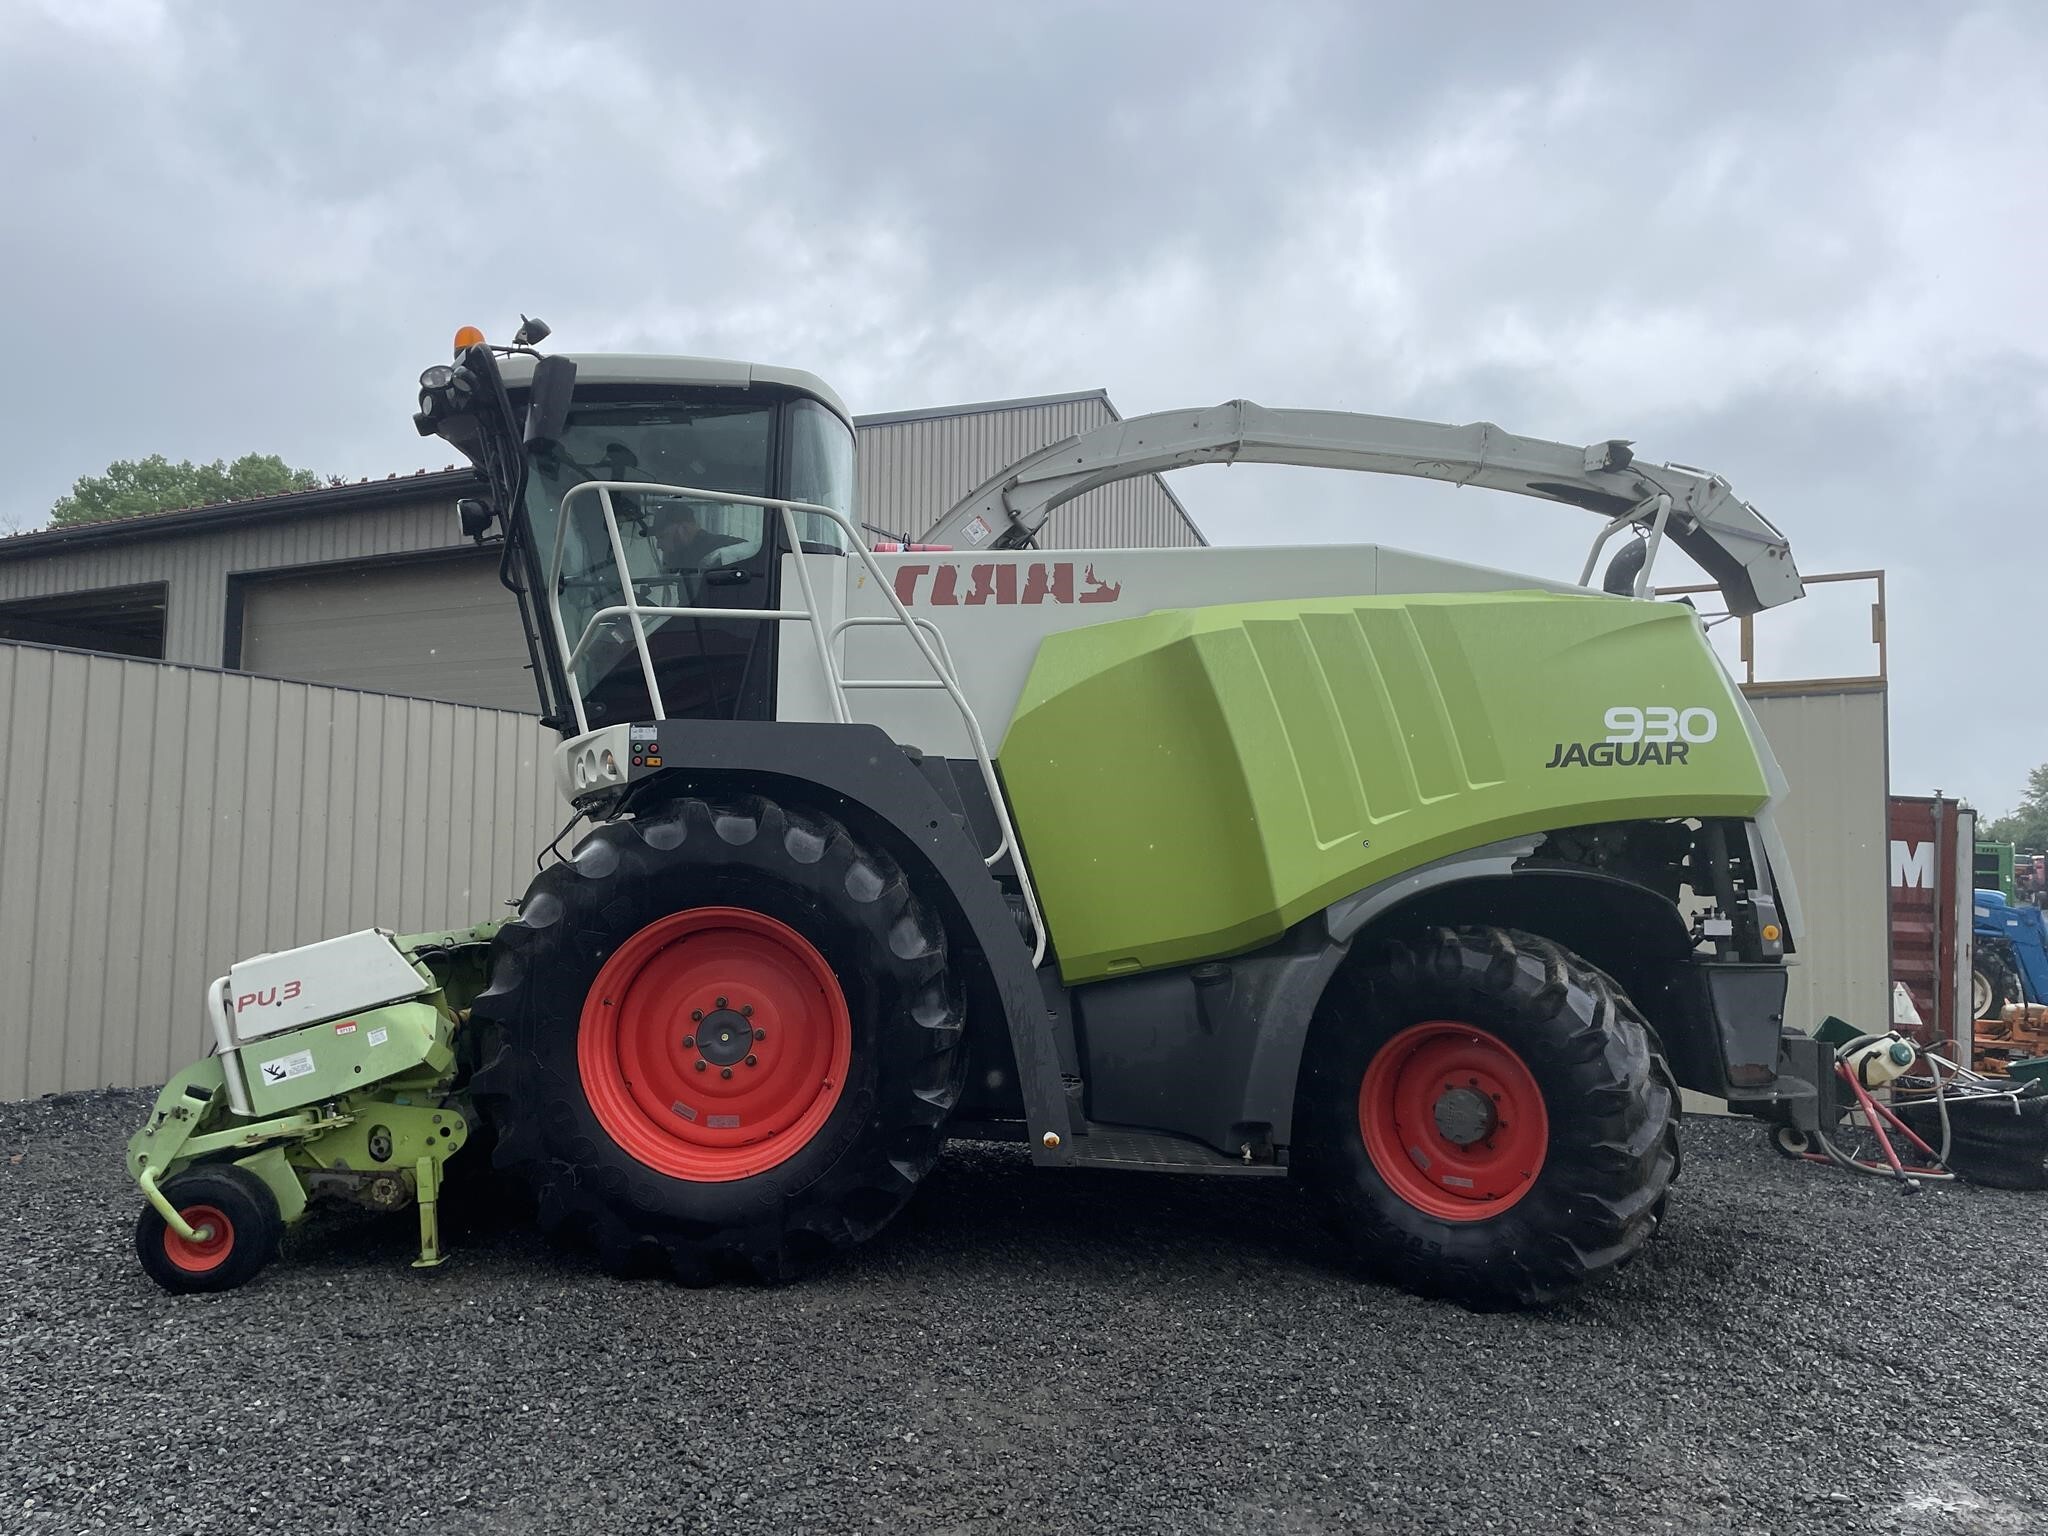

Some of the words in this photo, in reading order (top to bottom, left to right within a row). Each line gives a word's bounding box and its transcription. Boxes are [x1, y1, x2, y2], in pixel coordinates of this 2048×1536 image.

[1603, 706, 1718, 744] 930
[1545, 741, 1690, 769] JAGUAR
[1890, 839, 1935, 889] M
